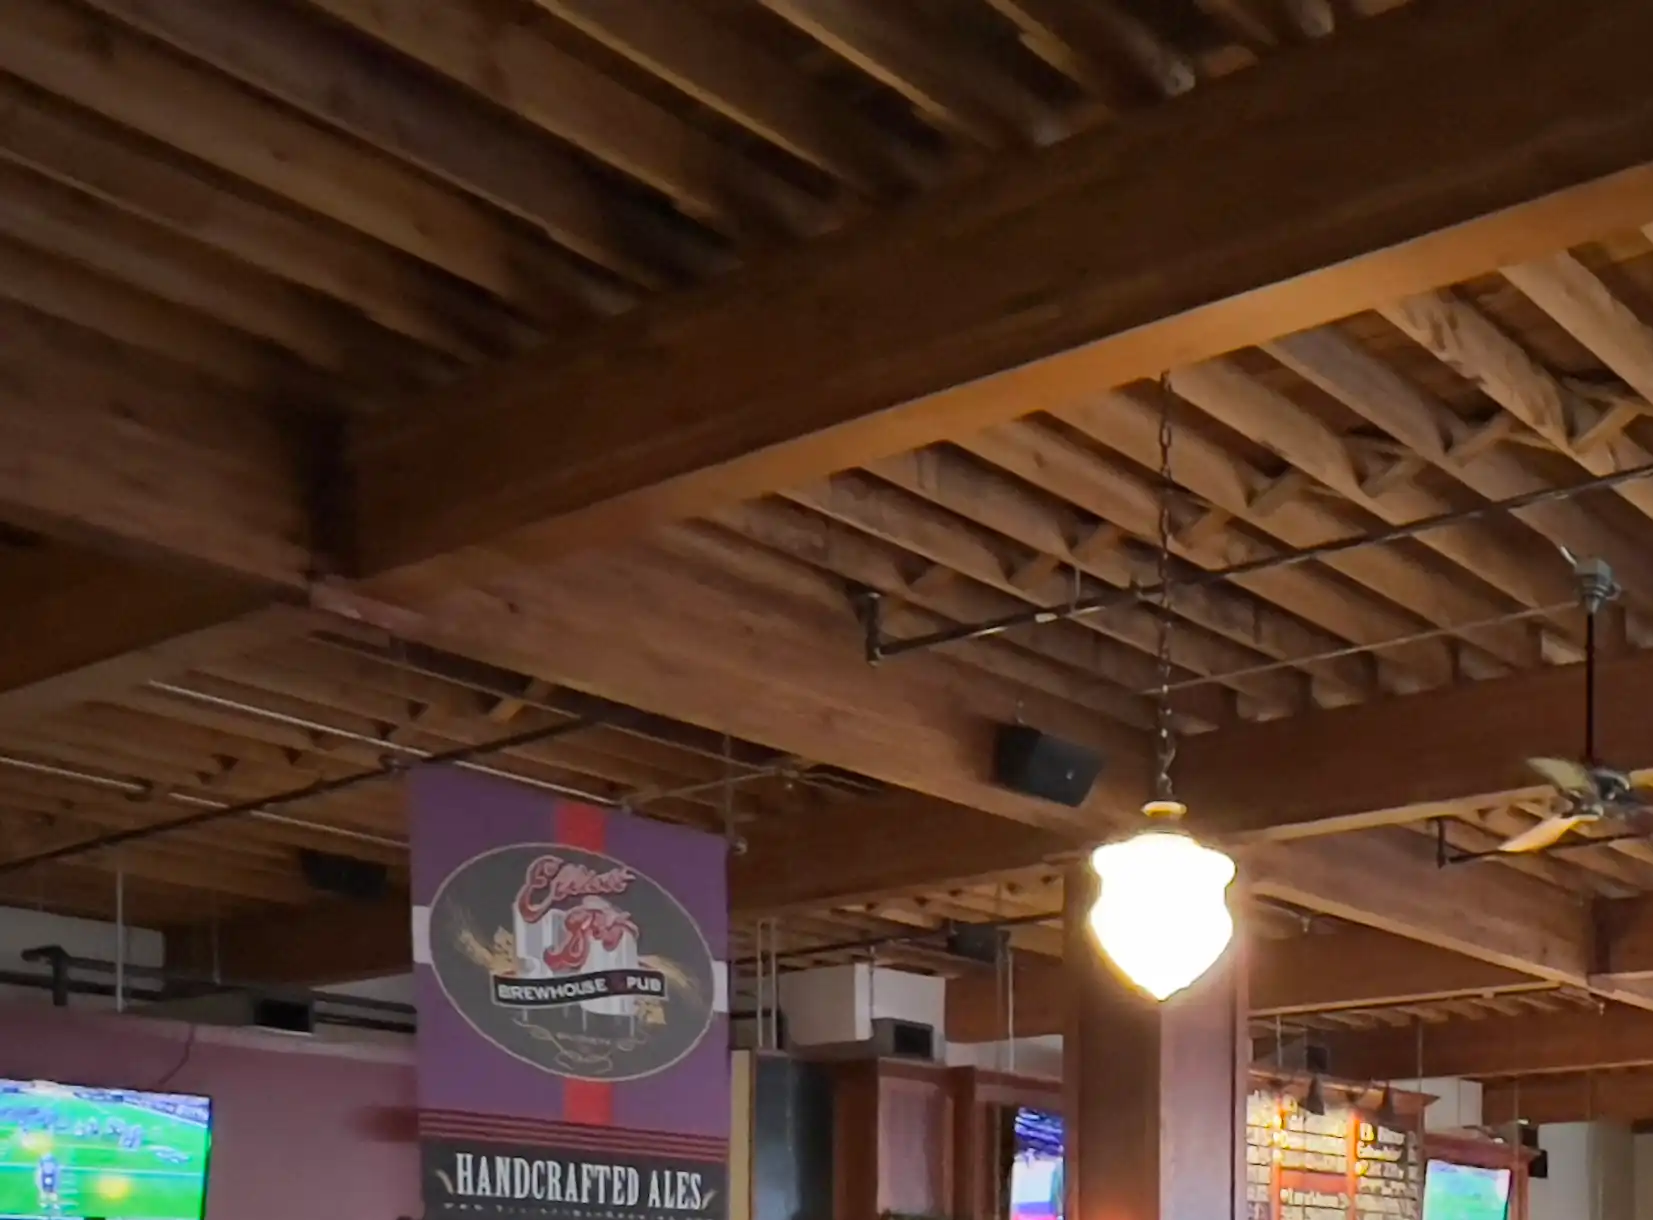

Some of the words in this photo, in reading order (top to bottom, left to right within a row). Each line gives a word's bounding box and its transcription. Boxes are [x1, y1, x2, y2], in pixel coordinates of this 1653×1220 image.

[498, 978, 607, 1000] BREWHOUSE
[626, 976, 662, 992] PUB
[455, 1152, 640, 1207] HANDCRAFTED
[648, 1170, 703, 1210] ALES
